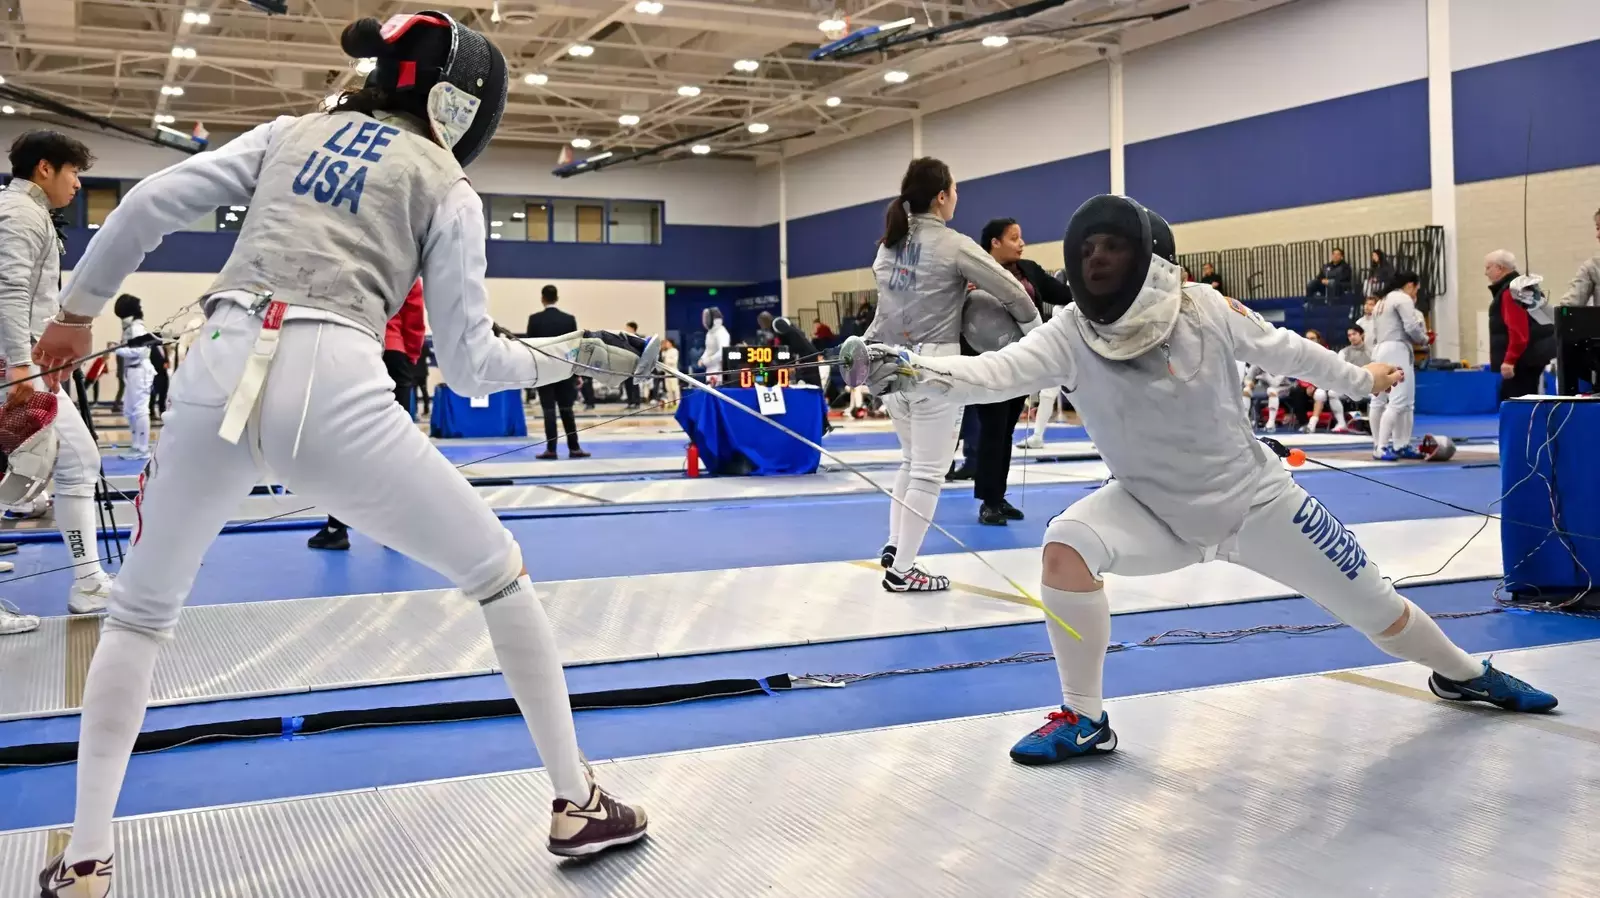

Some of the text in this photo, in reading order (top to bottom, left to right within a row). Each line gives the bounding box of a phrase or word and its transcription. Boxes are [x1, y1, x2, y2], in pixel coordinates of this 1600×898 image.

[323, 121, 400, 163] LEE
[292, 150, 368, 215] USA
[889, 267, 917, 291] USA
[746, 347, 772, 363] 3:00
[740, 367, 752, 388] 0
[778, 368, 789, 388] 0
[763, 391, 779, 403] B1
[66, 529, 86, 559] FENCING
[1292, 496, 1368, 581] CONVERSE
